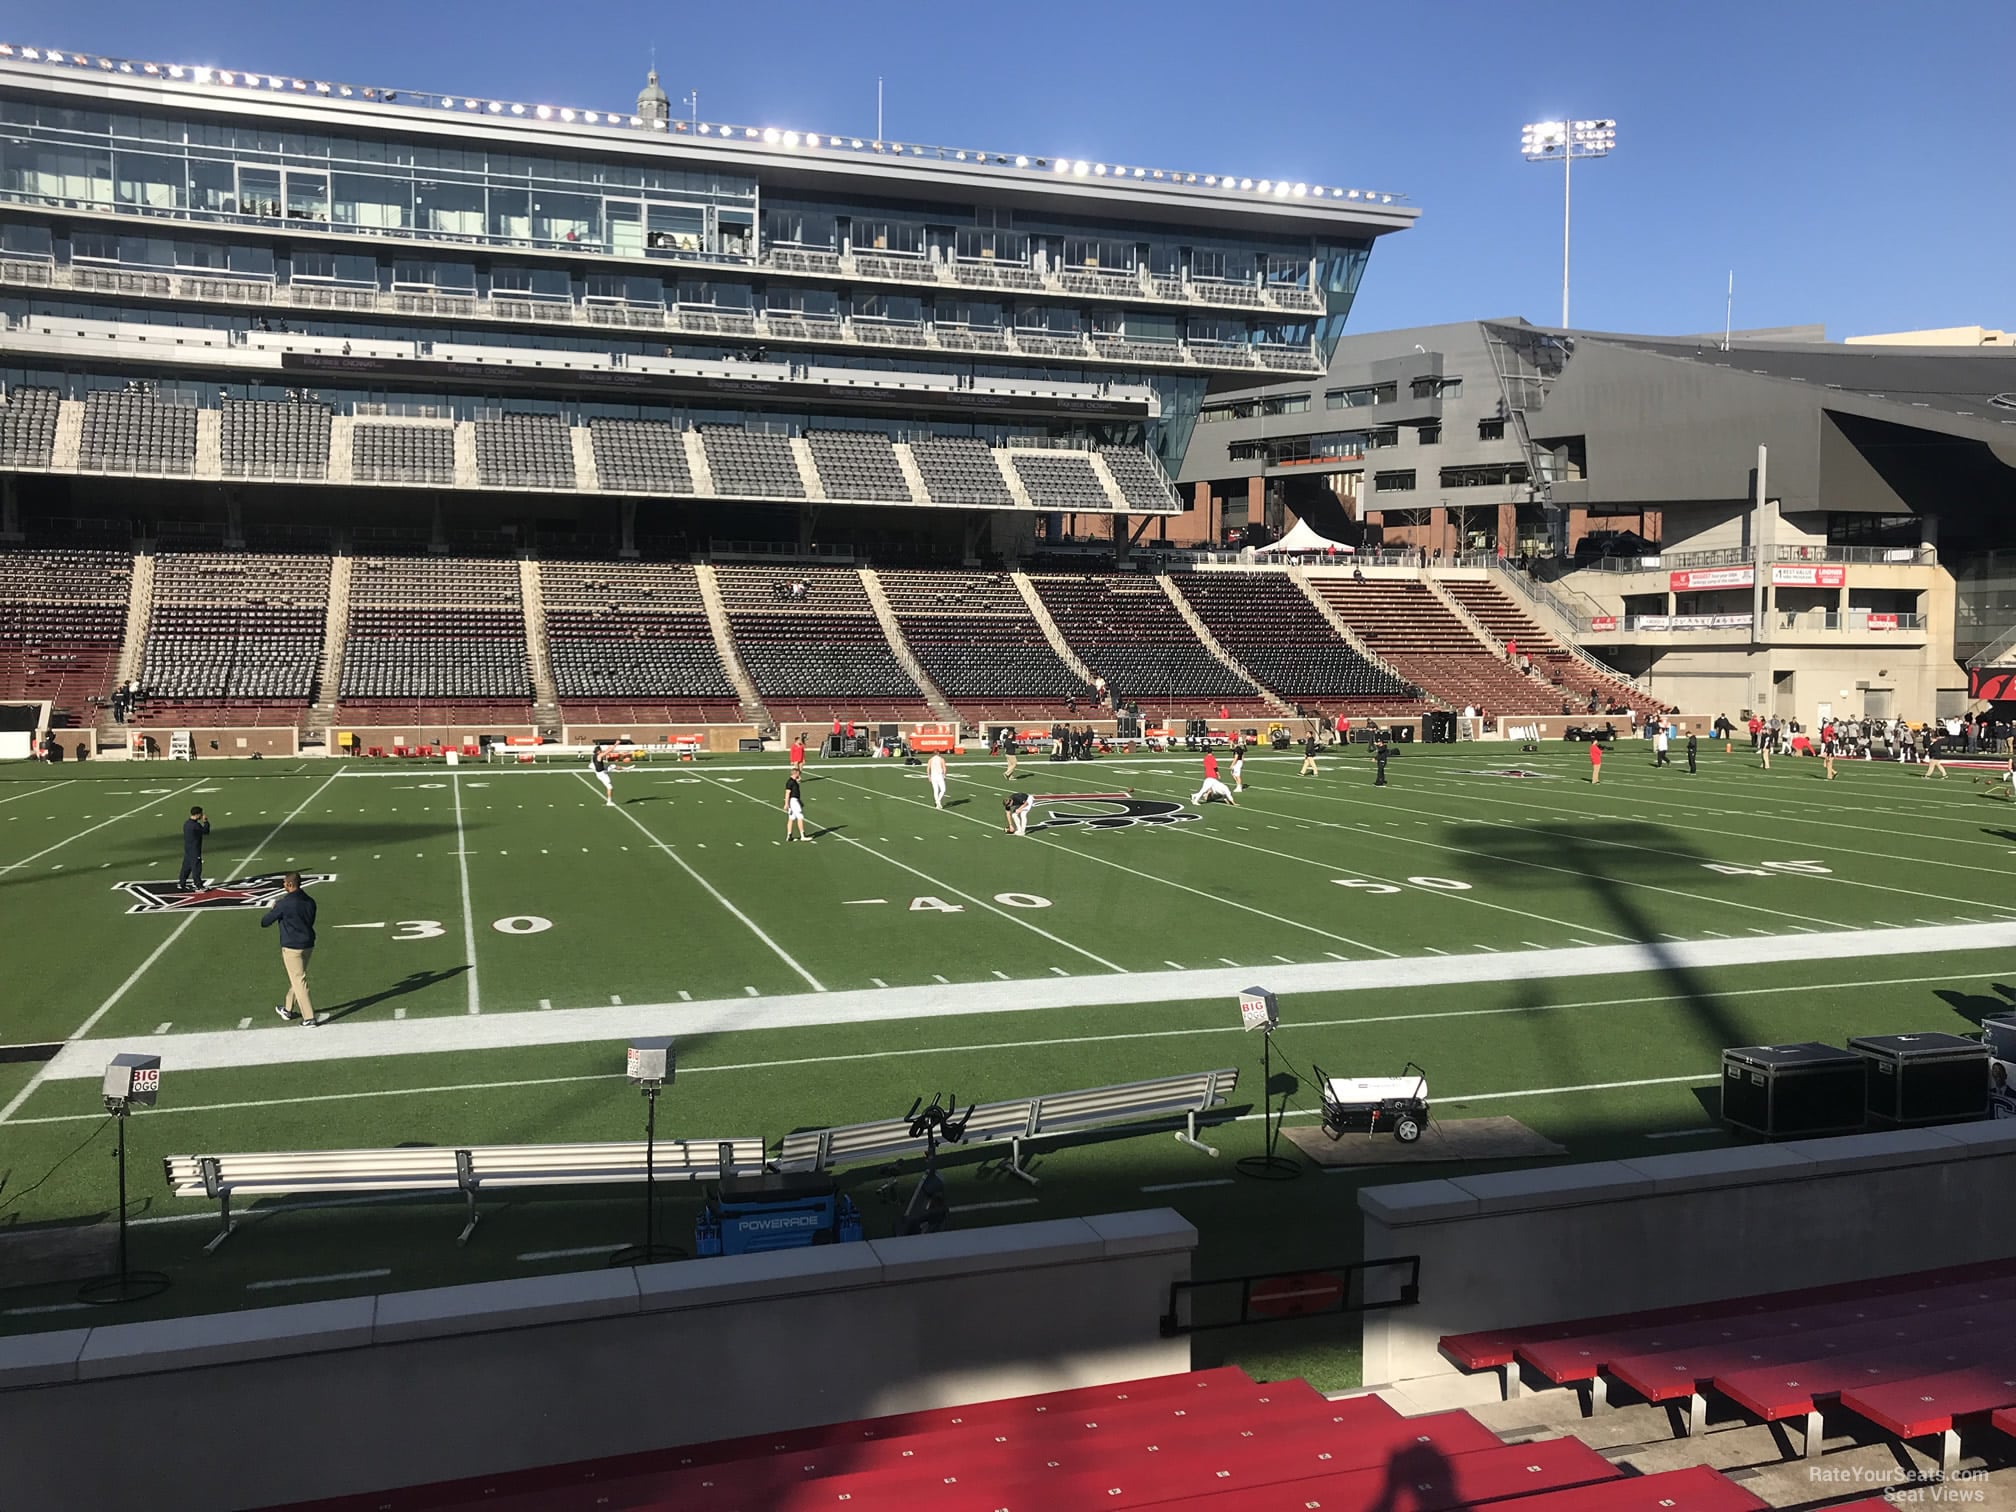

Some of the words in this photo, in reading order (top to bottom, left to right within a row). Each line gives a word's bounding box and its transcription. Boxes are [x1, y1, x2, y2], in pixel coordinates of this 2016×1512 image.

[1242, 1001, 1264, 1013] BIG
[132, 1070, 158, 1081] BIG
[134, 1081, 158, 1091] OGG
[739, 1215, 818, 1231] POWERADE
